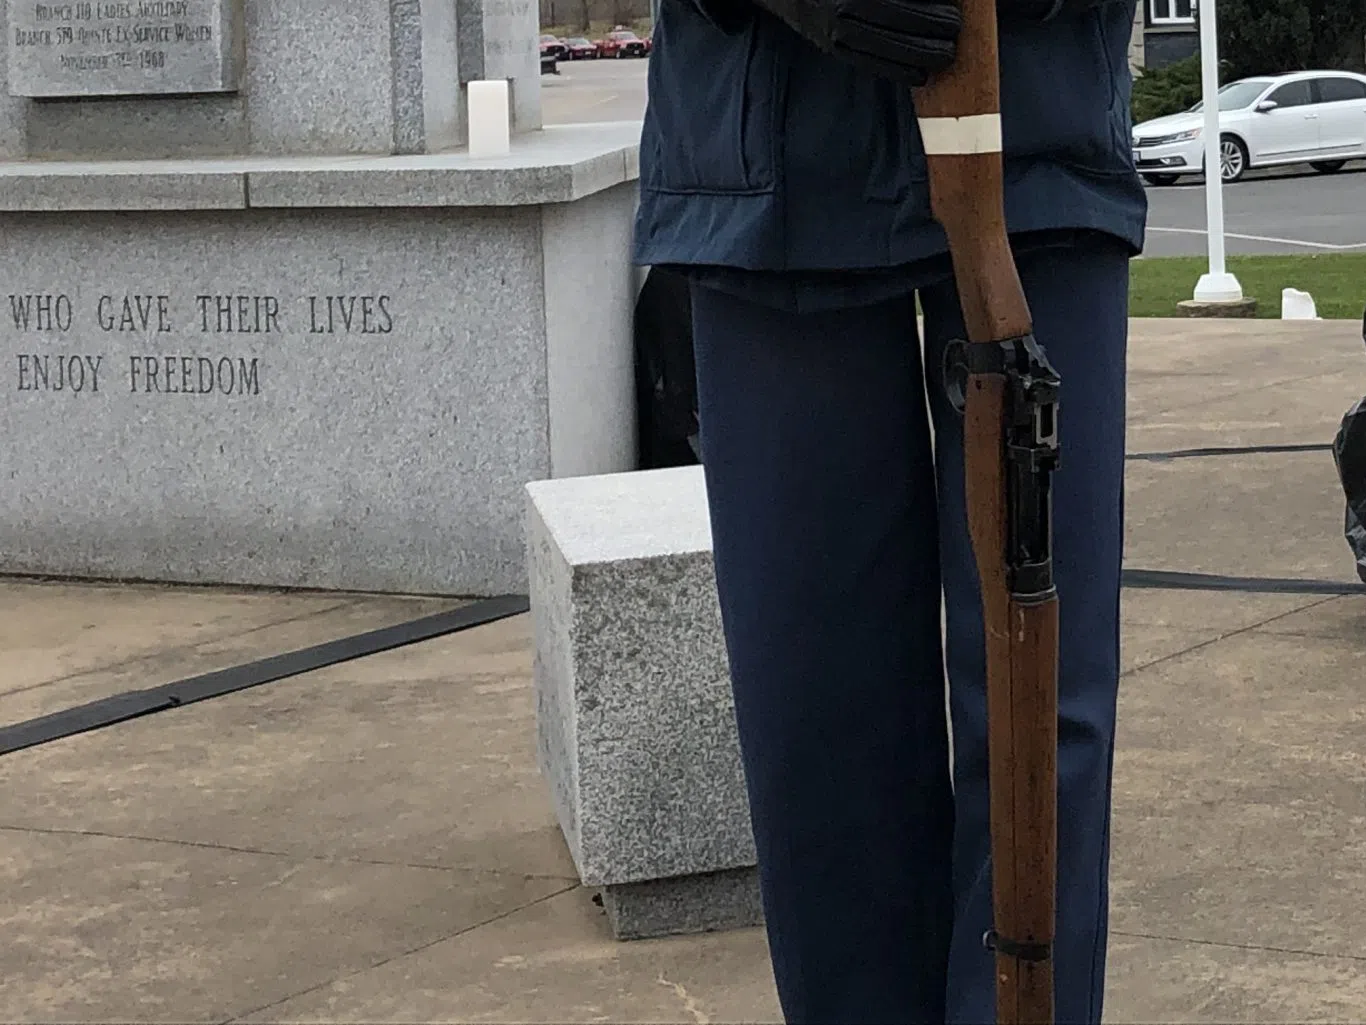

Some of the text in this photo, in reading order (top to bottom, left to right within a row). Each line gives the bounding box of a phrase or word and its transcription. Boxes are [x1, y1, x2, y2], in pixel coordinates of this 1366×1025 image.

[8, 294, 393, 334] WHO GAVE THEIR LIVES
[17, 354, 260, 395] ENJOY FREEDOM
